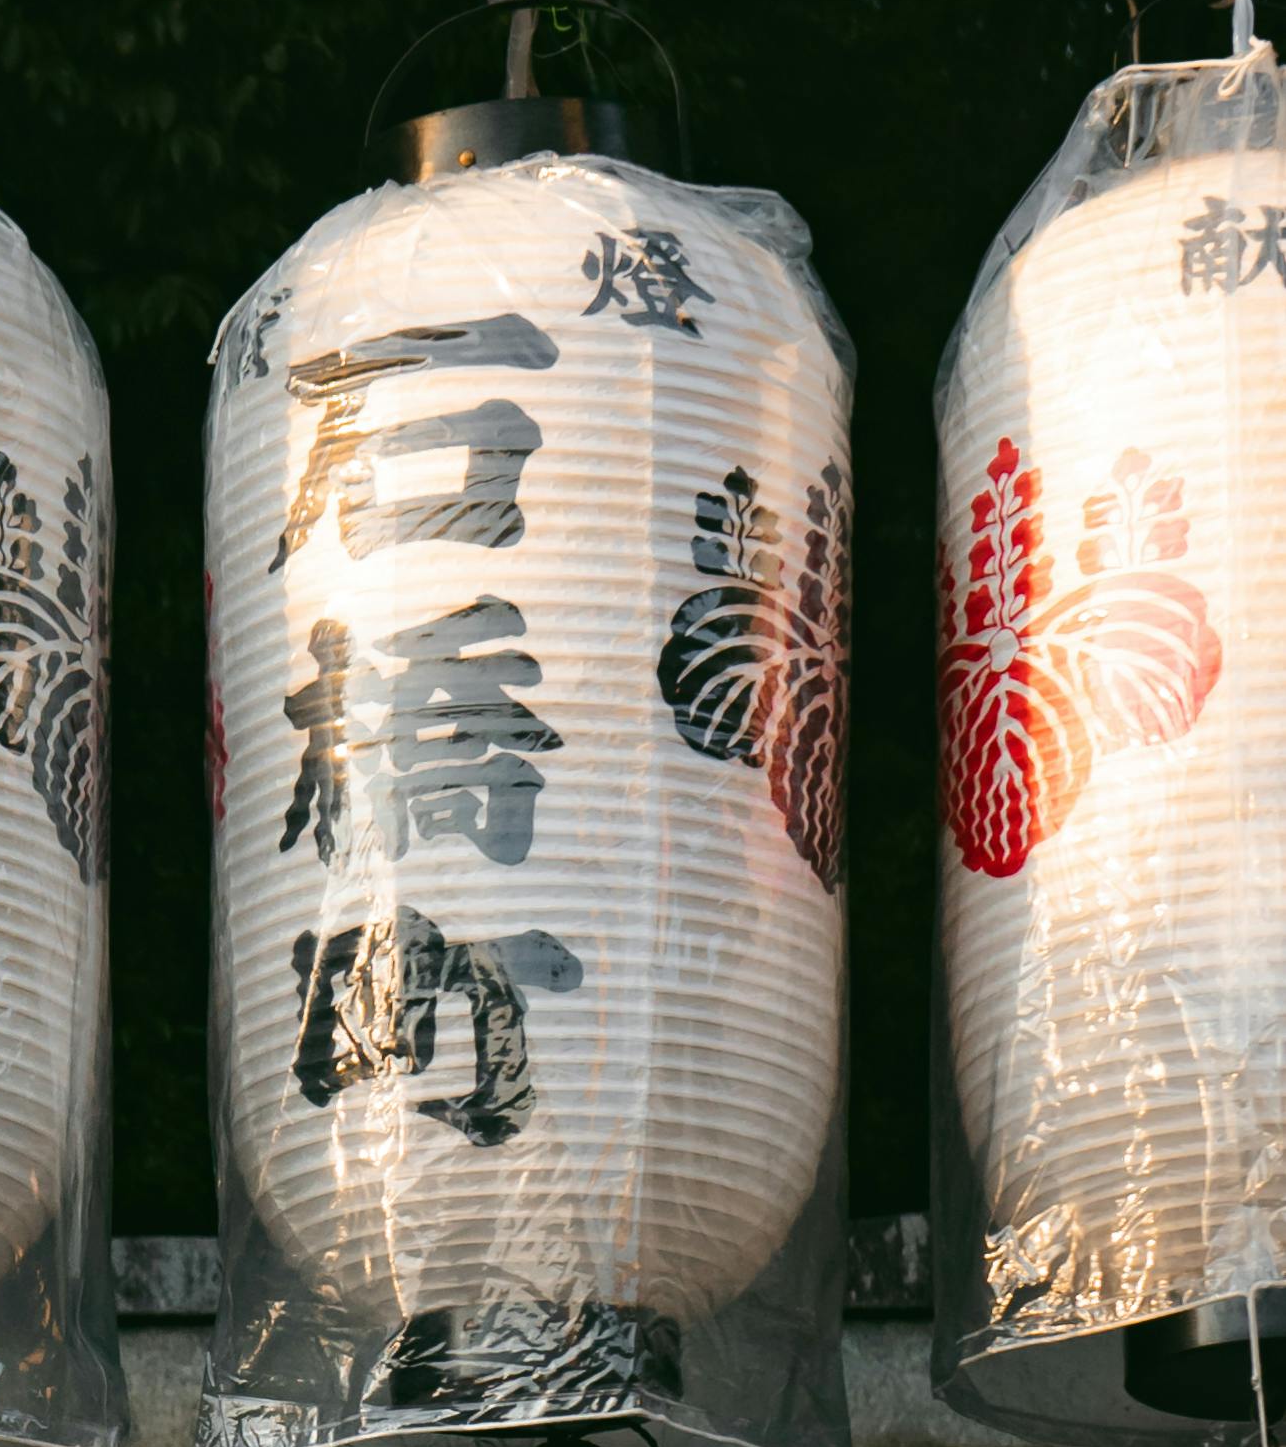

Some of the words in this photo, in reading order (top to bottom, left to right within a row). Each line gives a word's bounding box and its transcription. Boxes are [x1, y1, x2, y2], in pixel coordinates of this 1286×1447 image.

[581, 228, 717, 337] 燈
[1181, 196, 1286, 296] 献
[269, 314, 584, 1147] 石橋町
